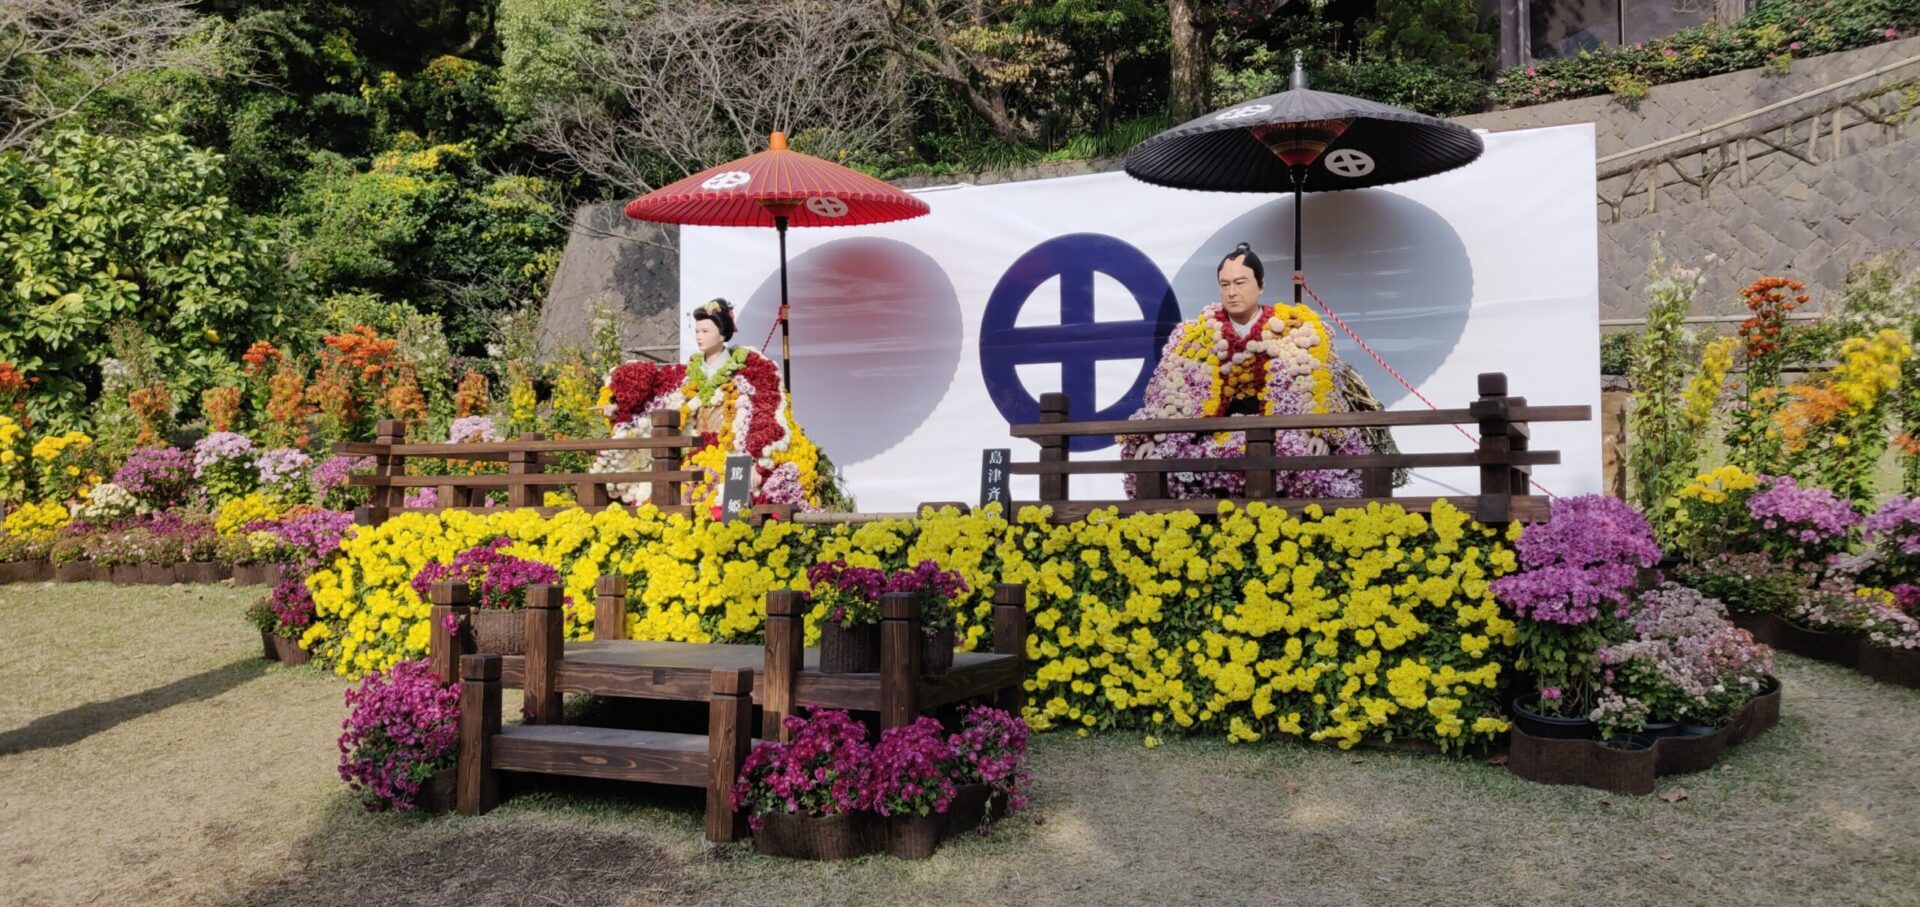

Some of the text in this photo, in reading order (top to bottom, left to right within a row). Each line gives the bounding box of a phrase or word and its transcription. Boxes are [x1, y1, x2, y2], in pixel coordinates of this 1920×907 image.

[728, 466, 744, 513] 篤姫
[987, 450, 1003, 518] 島津斉
